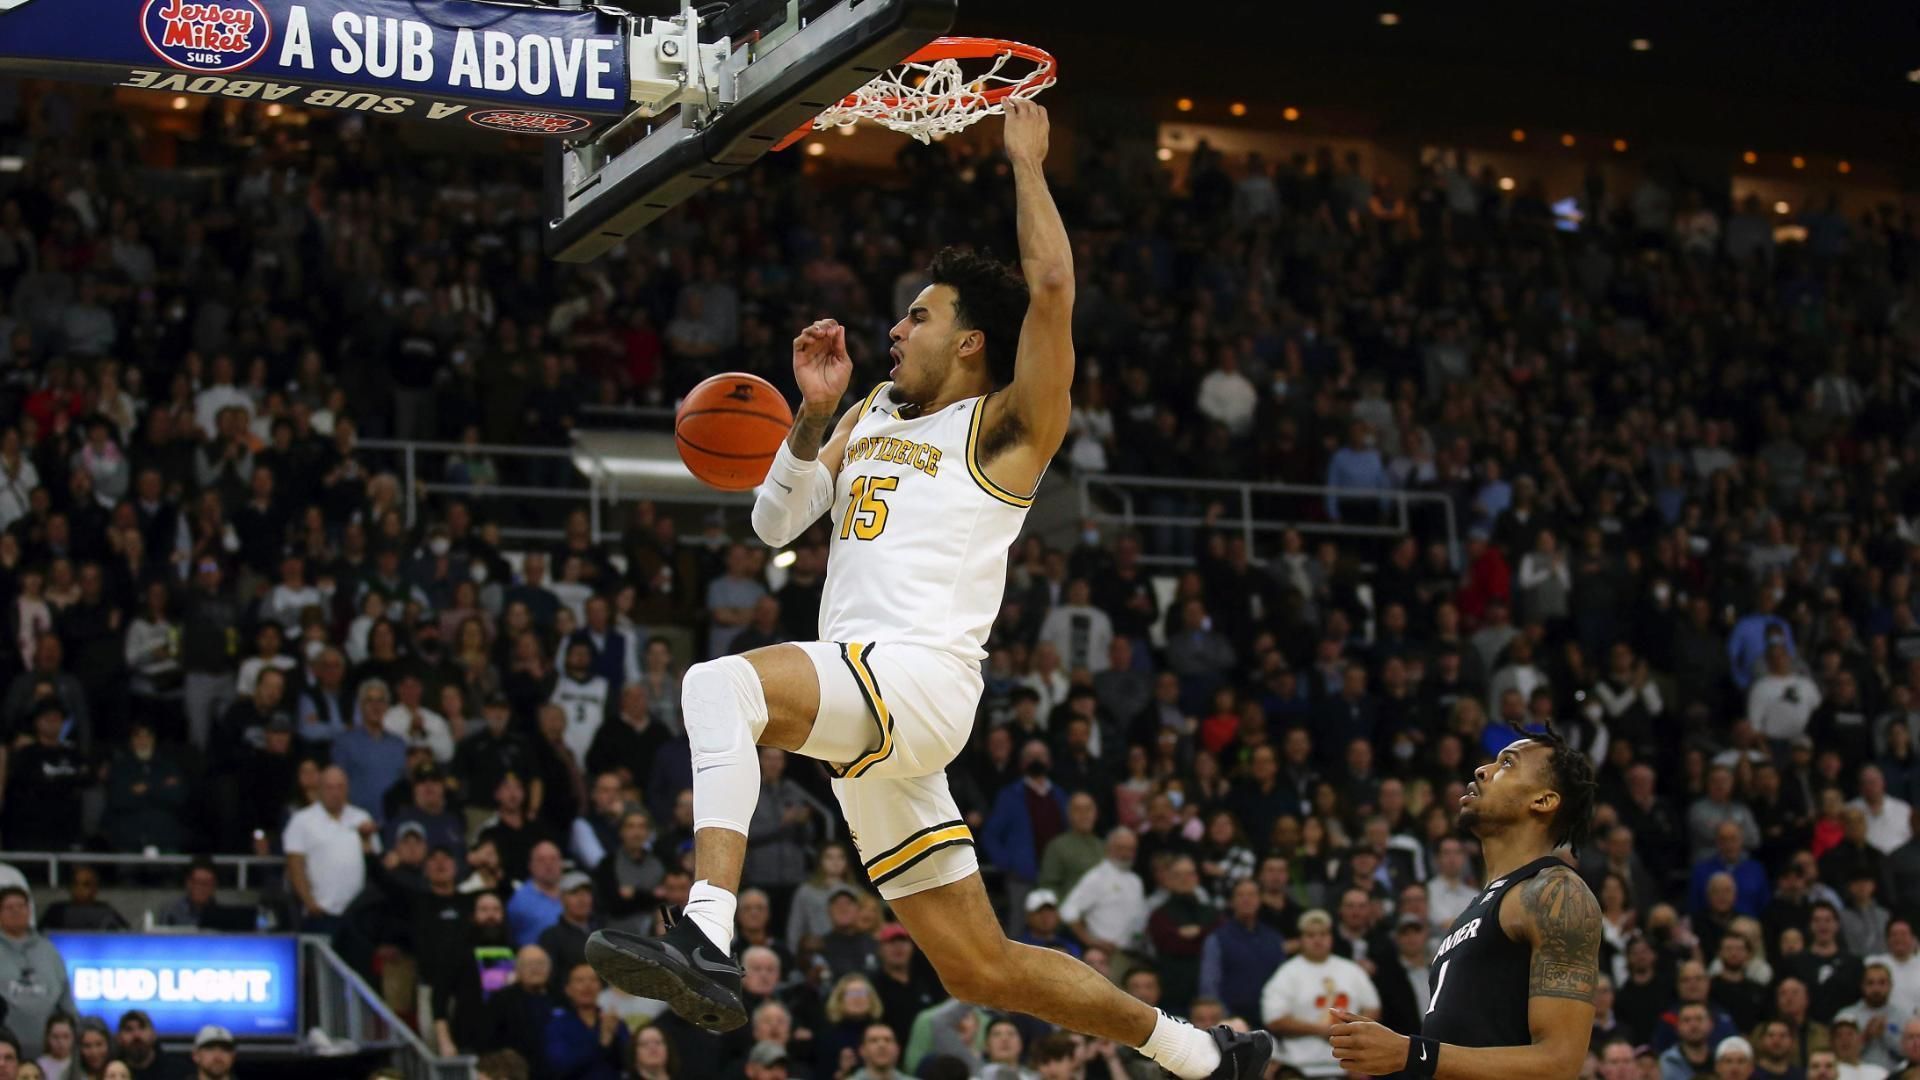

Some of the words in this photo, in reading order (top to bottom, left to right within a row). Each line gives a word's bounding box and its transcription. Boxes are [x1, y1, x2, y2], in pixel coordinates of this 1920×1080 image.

[159, 0, 255, 33] Jersey
[162, 18, 251, 53] Mike's
[279, 5, 314, 70] A
[330, 10, 434, 82] SUB
[448, 27, 615, 100] ABOVE
[187, 52, 222, 65] SUBS
[119, 70, 302, 100] ABOVE
[303, 89, 415, 114] SUB
[426, 101, 467, 120] A
[839, 436, 943, 478] ROVIDENCE
[840, 475, 900, 541] 15
[1432, 917, 1482, 966] AVIER
[73, 967, 157, 1001] BUD
[158, 968, 272, 1002] LIGHT
[1425, 959, 1450, 1015] 1
